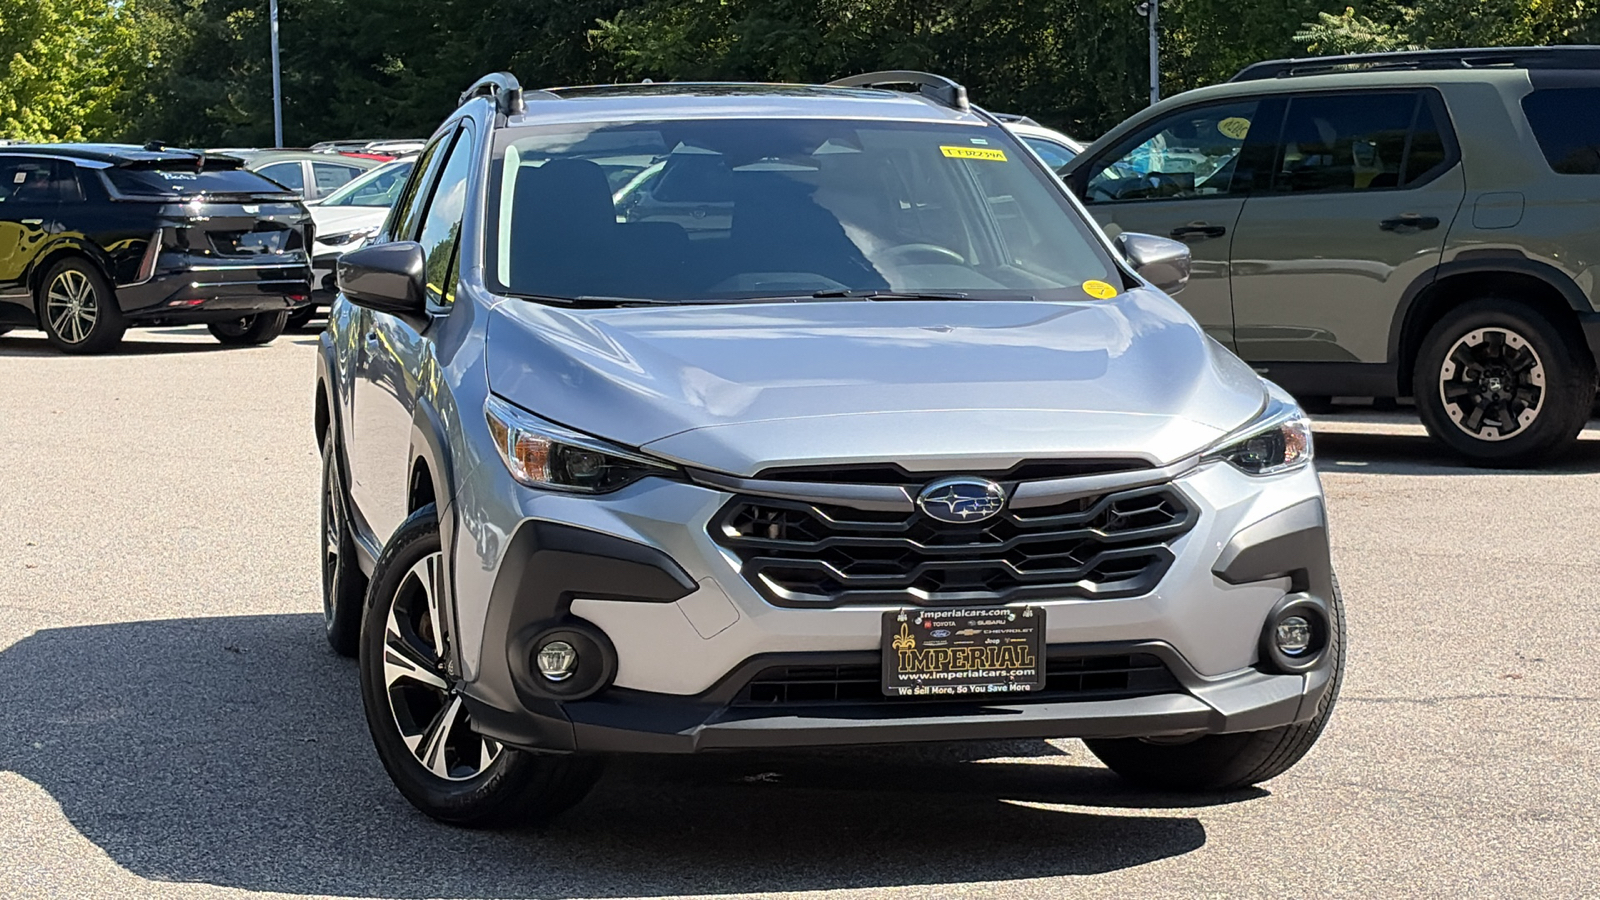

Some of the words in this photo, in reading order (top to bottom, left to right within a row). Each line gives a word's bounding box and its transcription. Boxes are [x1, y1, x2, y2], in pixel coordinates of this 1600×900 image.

[920, 608, 1011, 620] Imperialcars.com
[898, 645, 1035, 672] IMPERIAL
[898, 687, 912, 695] We
[914, 686, 930, 695] Sell
[931, 685, 955, 695] More,
[956, 684, 968, 694] So
[969, 684, 986, 693] You
[987, 684, 1008, 693] Save
[1009, 683, 1031, 691] More
